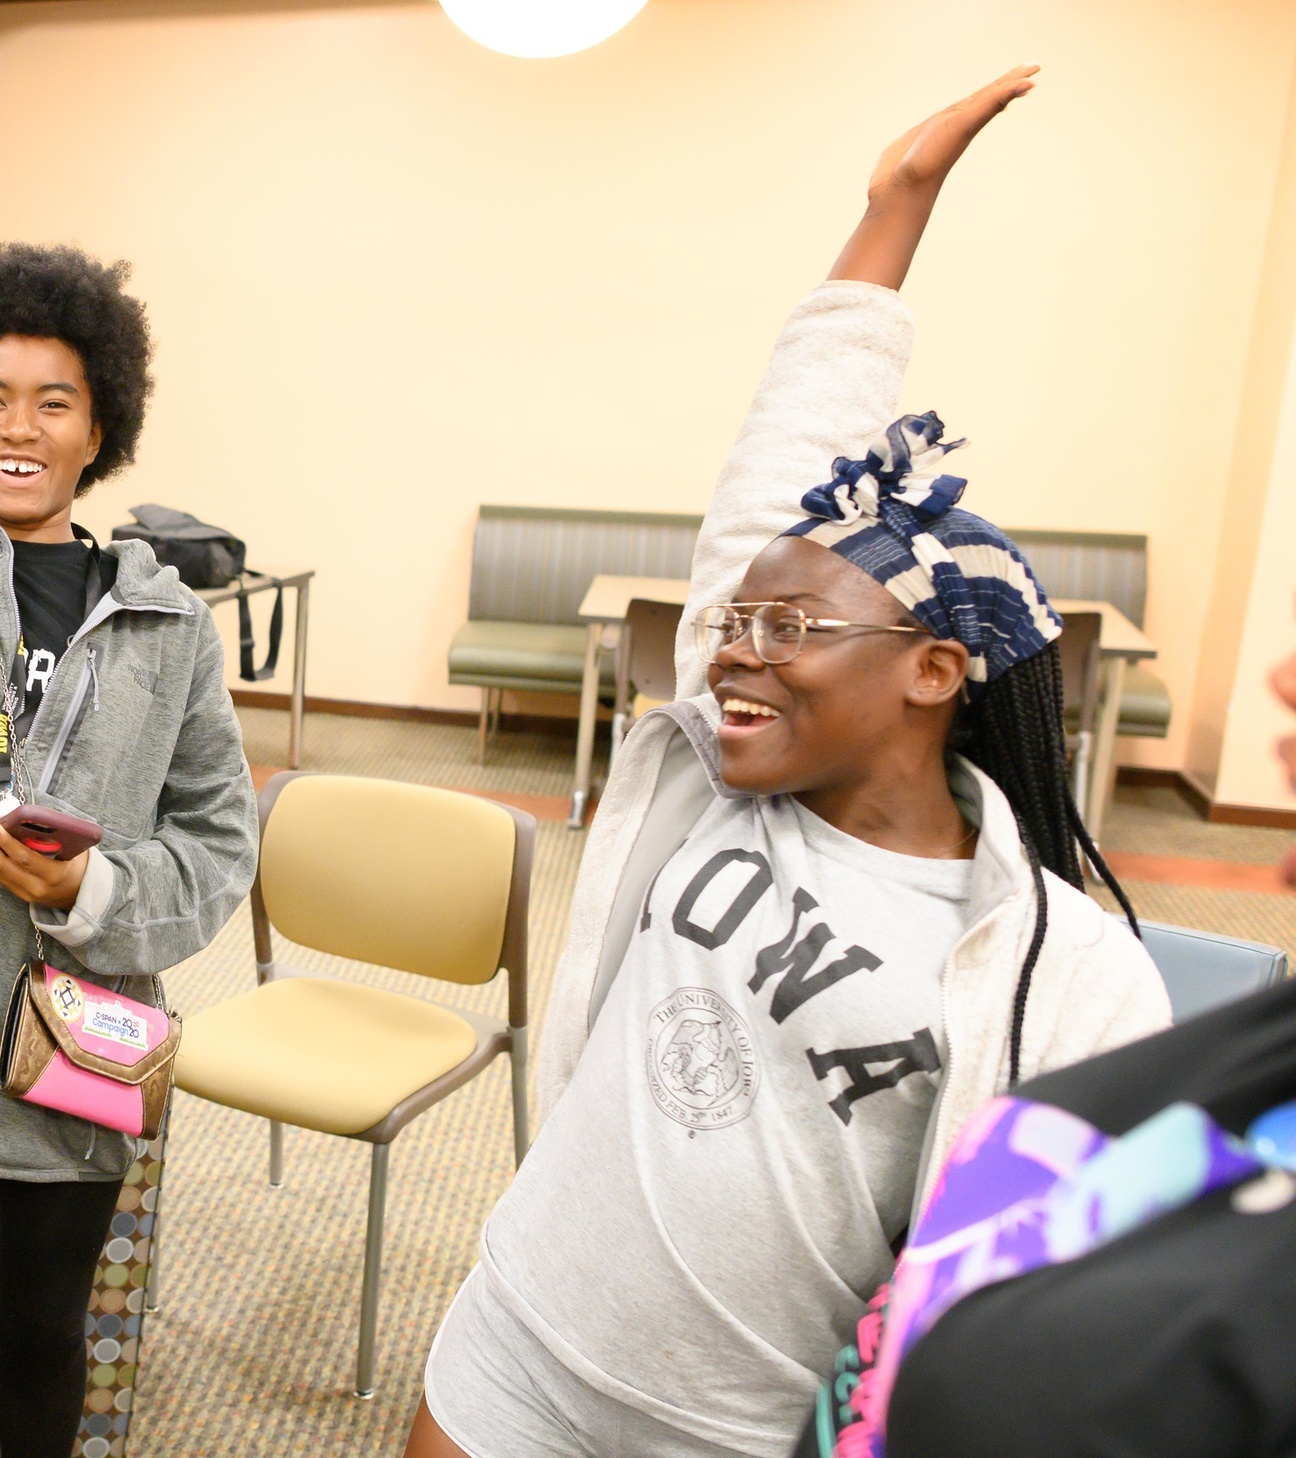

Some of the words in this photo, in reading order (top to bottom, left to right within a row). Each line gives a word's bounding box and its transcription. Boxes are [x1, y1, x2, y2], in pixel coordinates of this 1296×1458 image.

[92, 1018, 128, 1036] Campaign
[654, 1004, 678, 1023] THE
[737, 1037, 752, 1056] OF
